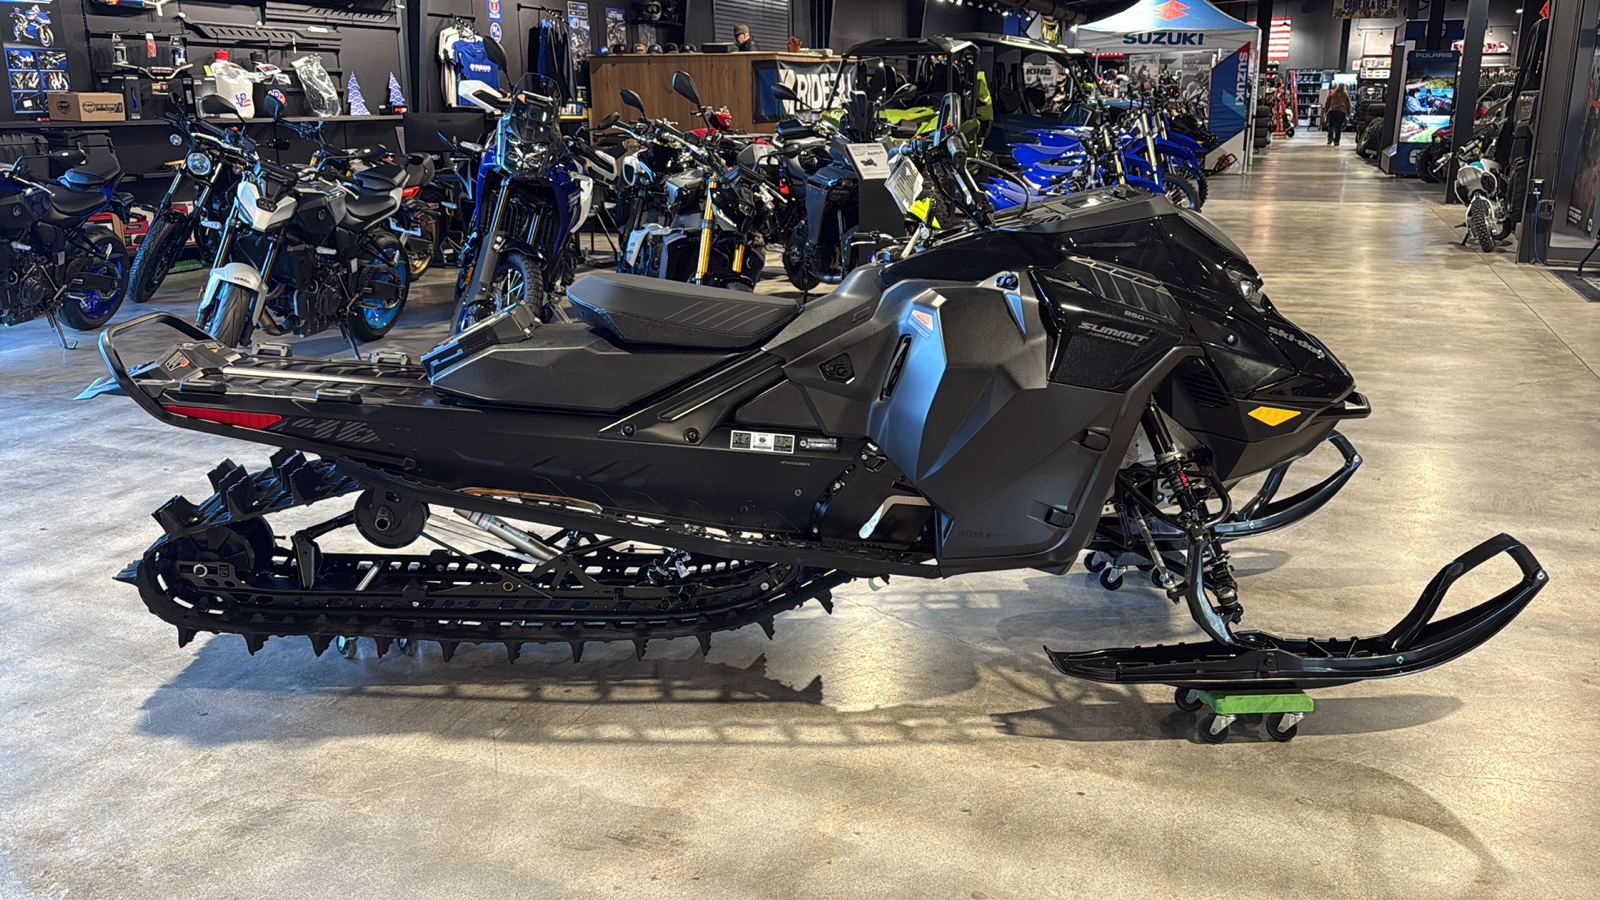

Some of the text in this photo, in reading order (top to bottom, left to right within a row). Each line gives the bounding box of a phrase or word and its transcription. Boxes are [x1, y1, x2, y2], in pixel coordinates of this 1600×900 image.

[1122, 31, 1204, 46] SUZUKI
[1235, 51, 1249, 106] SUZUKI
[1124, 310, 1145, 321] 850
[1078, 322, 1149, 342] SUMMIT
[1087, 331, 1141, 347] ADRENALINE
[957, 530, 993, 539] ROTAX
